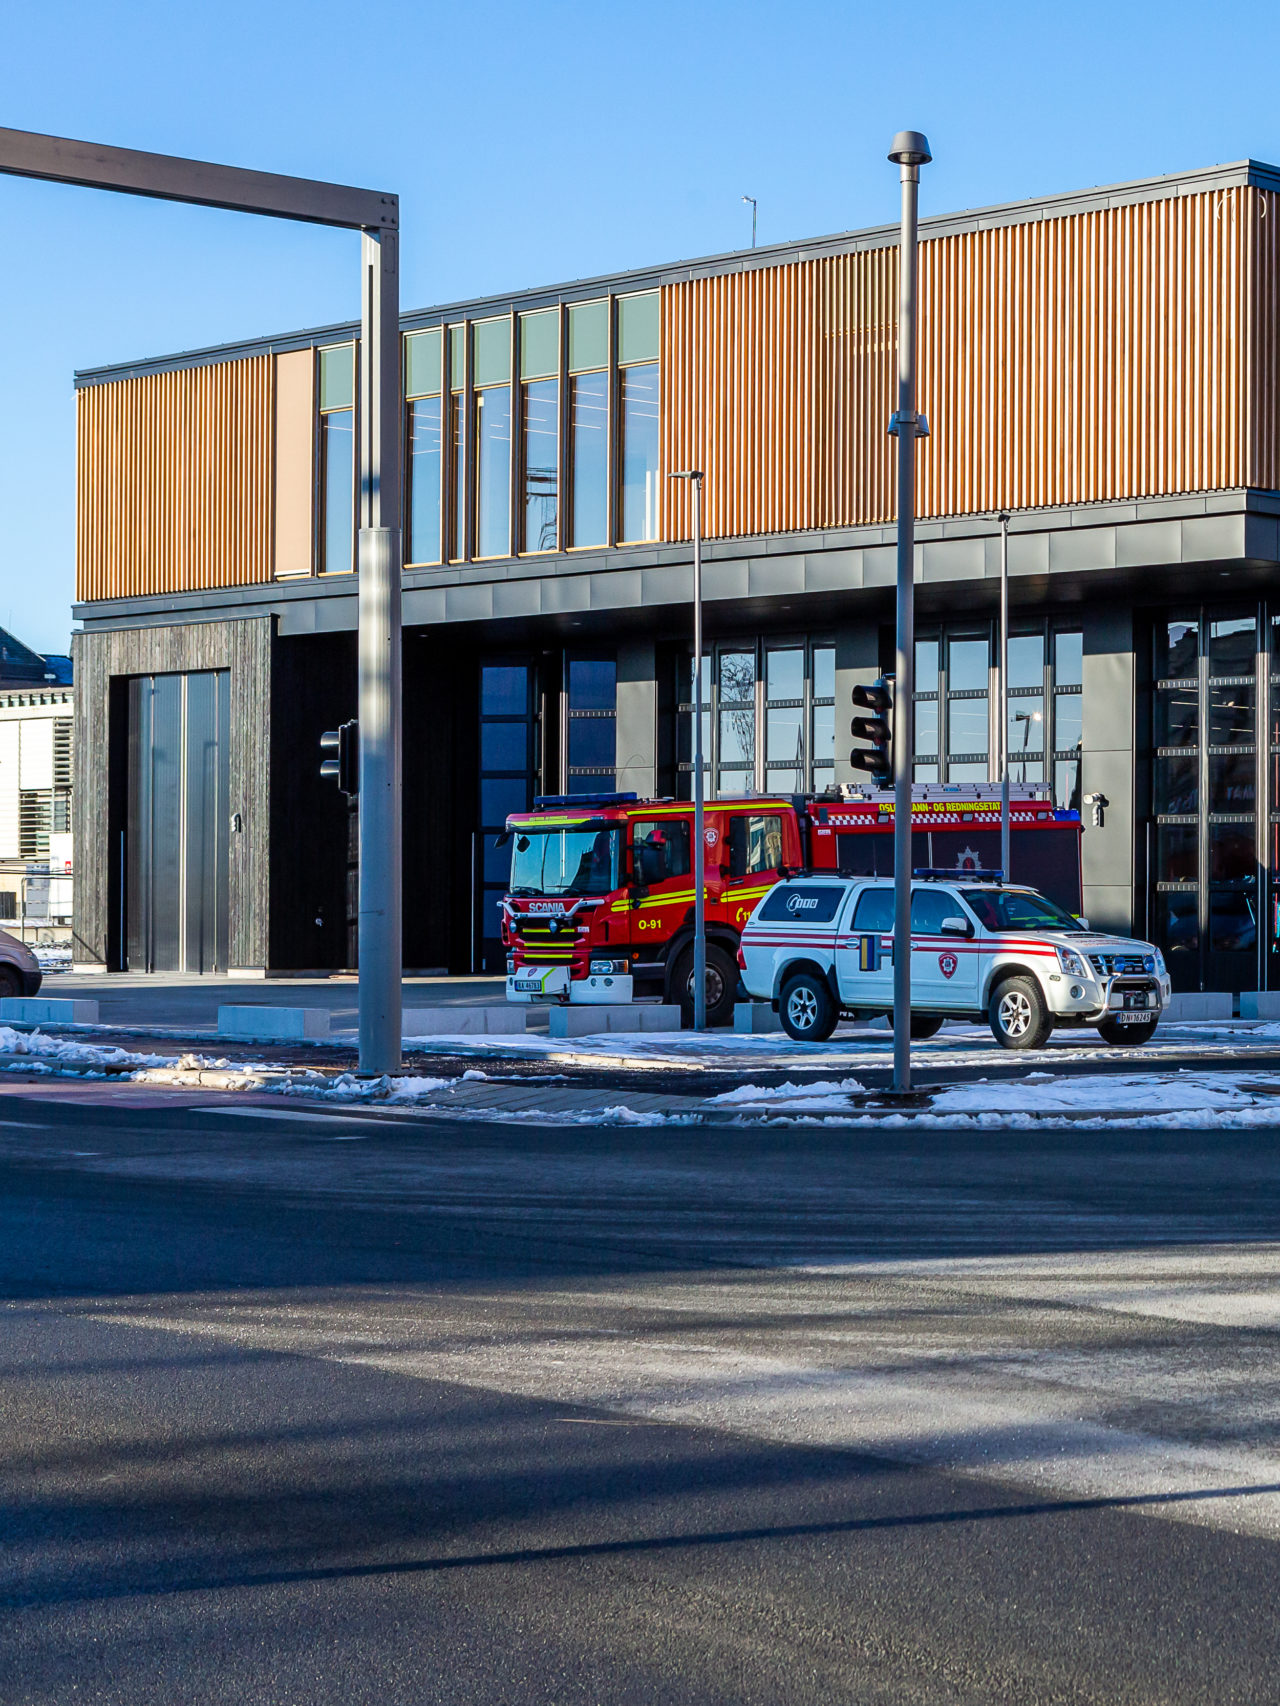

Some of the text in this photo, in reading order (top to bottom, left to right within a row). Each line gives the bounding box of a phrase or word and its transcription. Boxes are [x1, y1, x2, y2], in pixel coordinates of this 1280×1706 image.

[933, 802, 945, 812] OG
[946, 801, 1001, 812] REDNINGSETAT
[528, 902, 566, 913] SCANIA
[796, 898, 819, 909] 110
[638, 919, 662, 930] O-91
[1121, 1012, 1150, 1023] DN 16245
